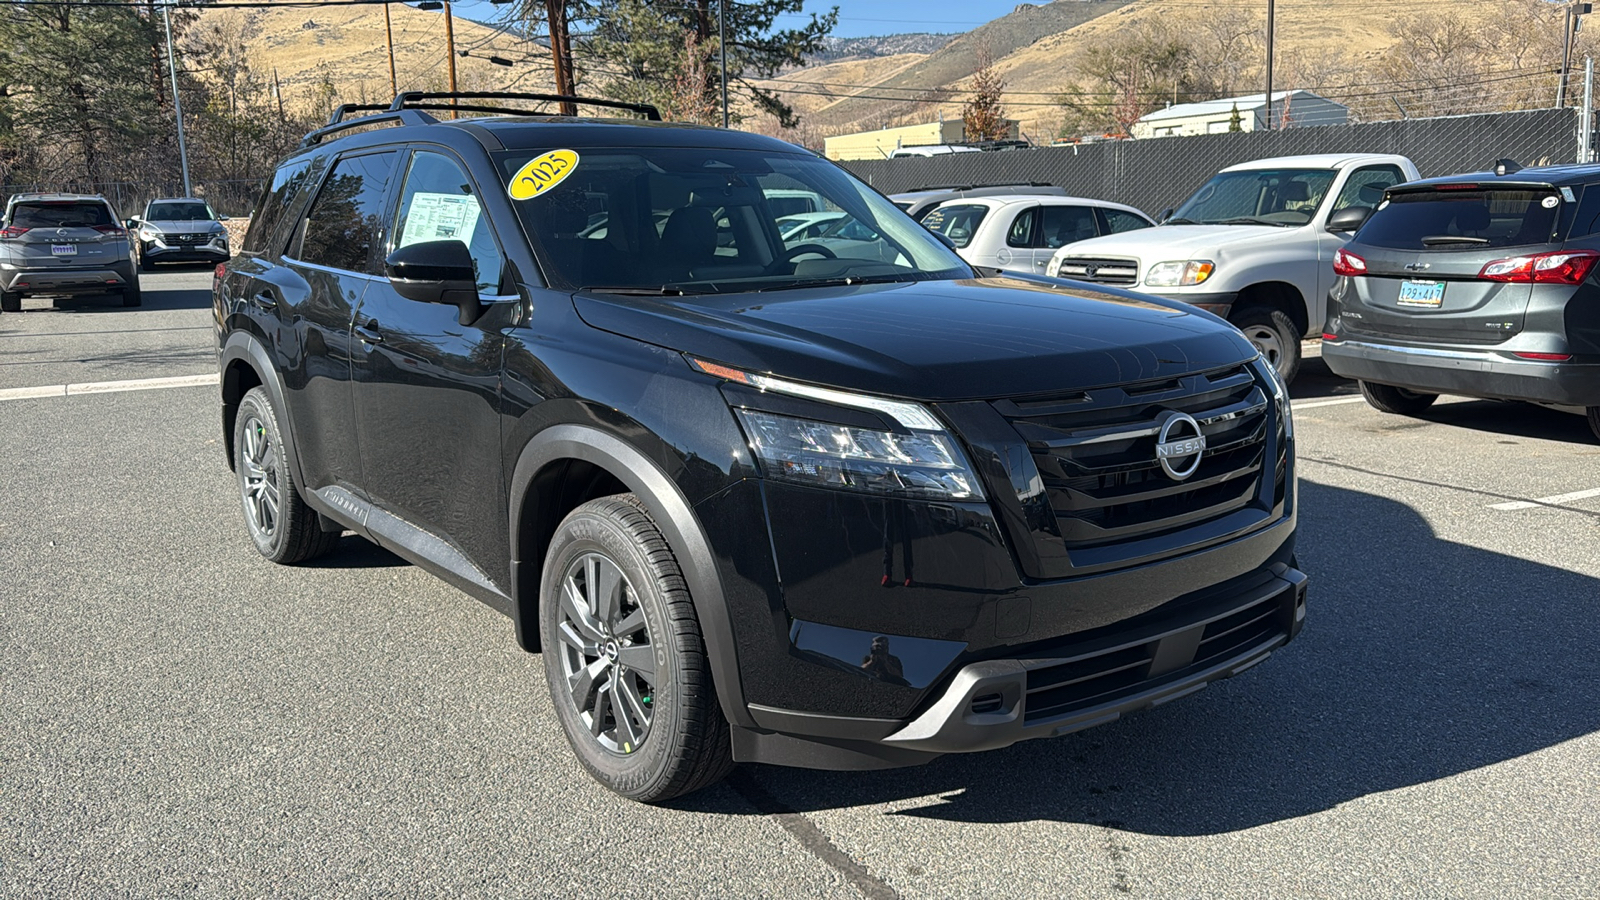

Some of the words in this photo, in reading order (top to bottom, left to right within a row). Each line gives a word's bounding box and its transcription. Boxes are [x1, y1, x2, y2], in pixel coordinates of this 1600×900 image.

[521, 154, 568, 191] 2025
[1158, 438, 1206, 456] NISSAN
[638, 584, 665, 666] KUMHO
